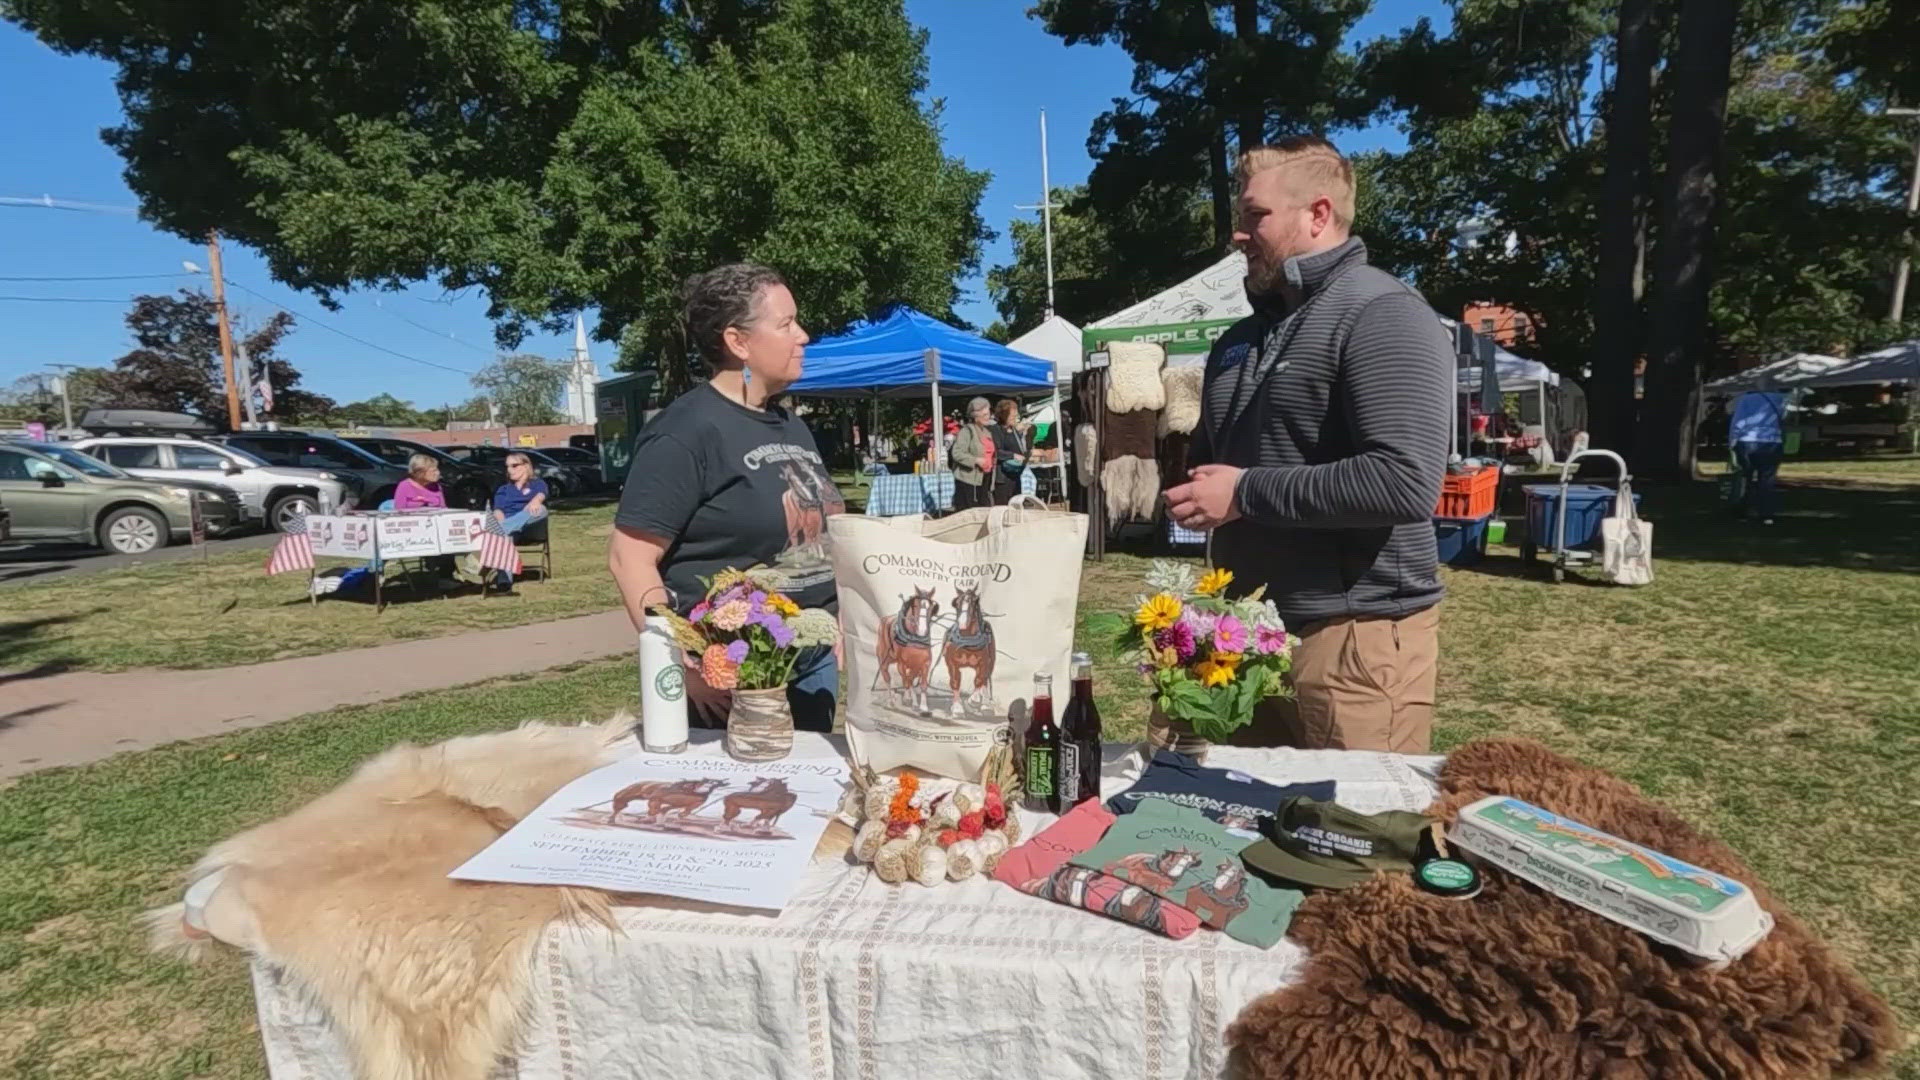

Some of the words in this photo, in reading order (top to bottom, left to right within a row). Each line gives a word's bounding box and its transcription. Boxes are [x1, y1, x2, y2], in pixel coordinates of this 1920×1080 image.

[1131, 328, 1200, 343] APPLE
[863, 554, 944, 574] COMMON
[949, 563, 1012, 583] GROUND
[898, 568, 949, 583] COUNTRY
[954, 578, 974, 587] FAIR
[1136, 826, 1221, 848] COMMON
[1325, 832, 1374, 850] ORGANIC
[529, 840, 631, 857] SEPTEMBER
[733, 859, 774, 869] 2025
[645, 861, 707, 873] MAINE
[1527, 855, 1567, 880] ORGANIC
